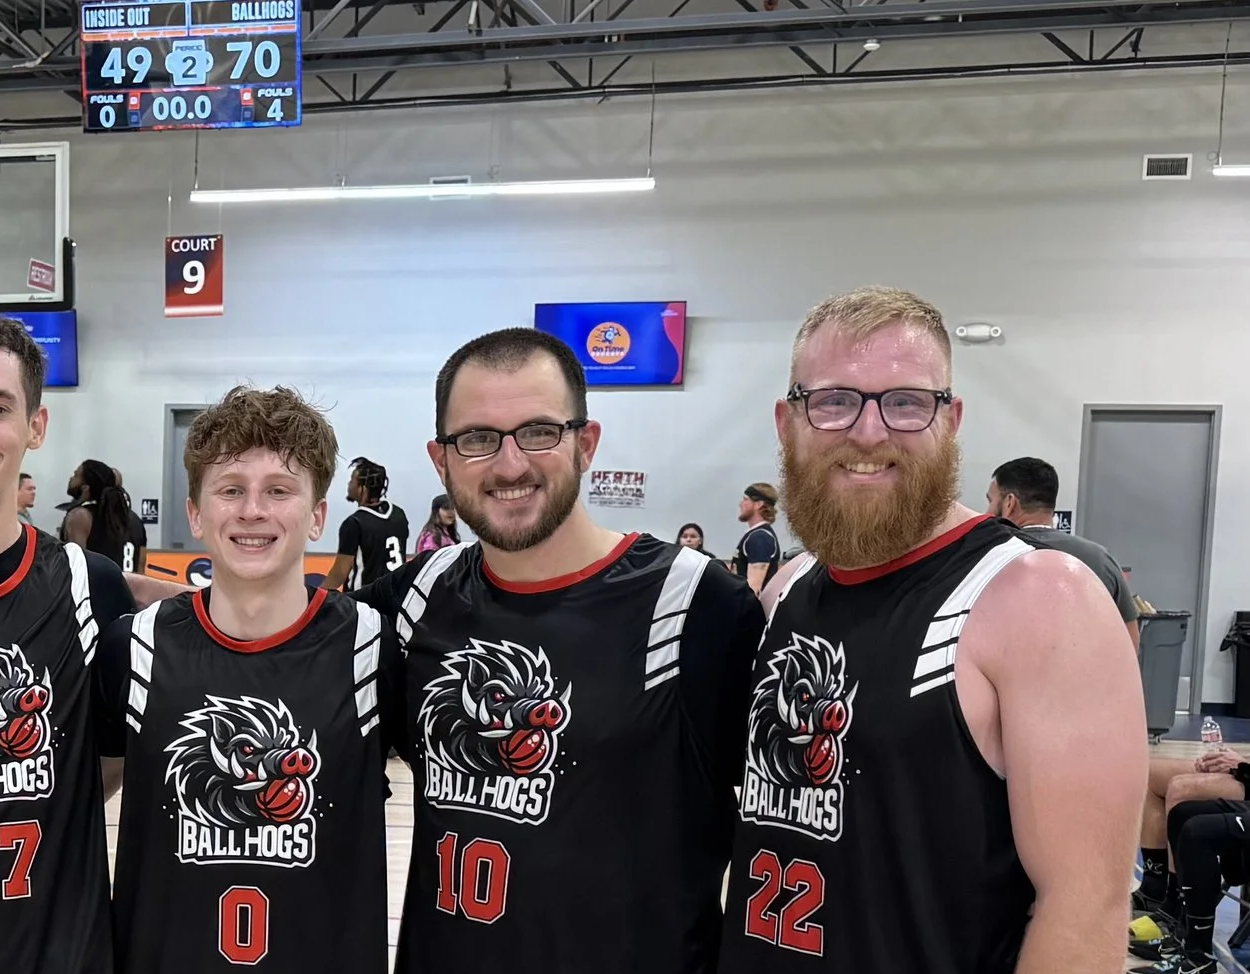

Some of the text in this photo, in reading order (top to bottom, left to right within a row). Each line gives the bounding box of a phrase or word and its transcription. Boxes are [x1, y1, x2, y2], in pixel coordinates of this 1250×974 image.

[86, 8, 150, 28] INSIDE OUT
[232, 1, 294, 21] BALLHOGS
[100, 46, 153, 84] 49
[182, 55, 197, 79] 2
[226, 40, 281, 79] 70
[90, 94, 124, 104] FOULS
[152, 95, 212, 120] 00.0
[257, 87, 293, 98] FOULS
[99, 105, 116, 128] 0
[266, 99, 284, 122] 4
[171, 238, 217, 252] COURT
[182, 260, 205, 294] 9
[385, 536, 403, 571] 3
[427, 761, 546, 816] BALL HOGS
[744, 772, 838, 831] BALL HOGS
[182, 818, 309, 859] BALL HOGS
[436, 831, 511, 924] 10
[745, 849, 825, 957] 22
[218, 885, 269, 965] 0
